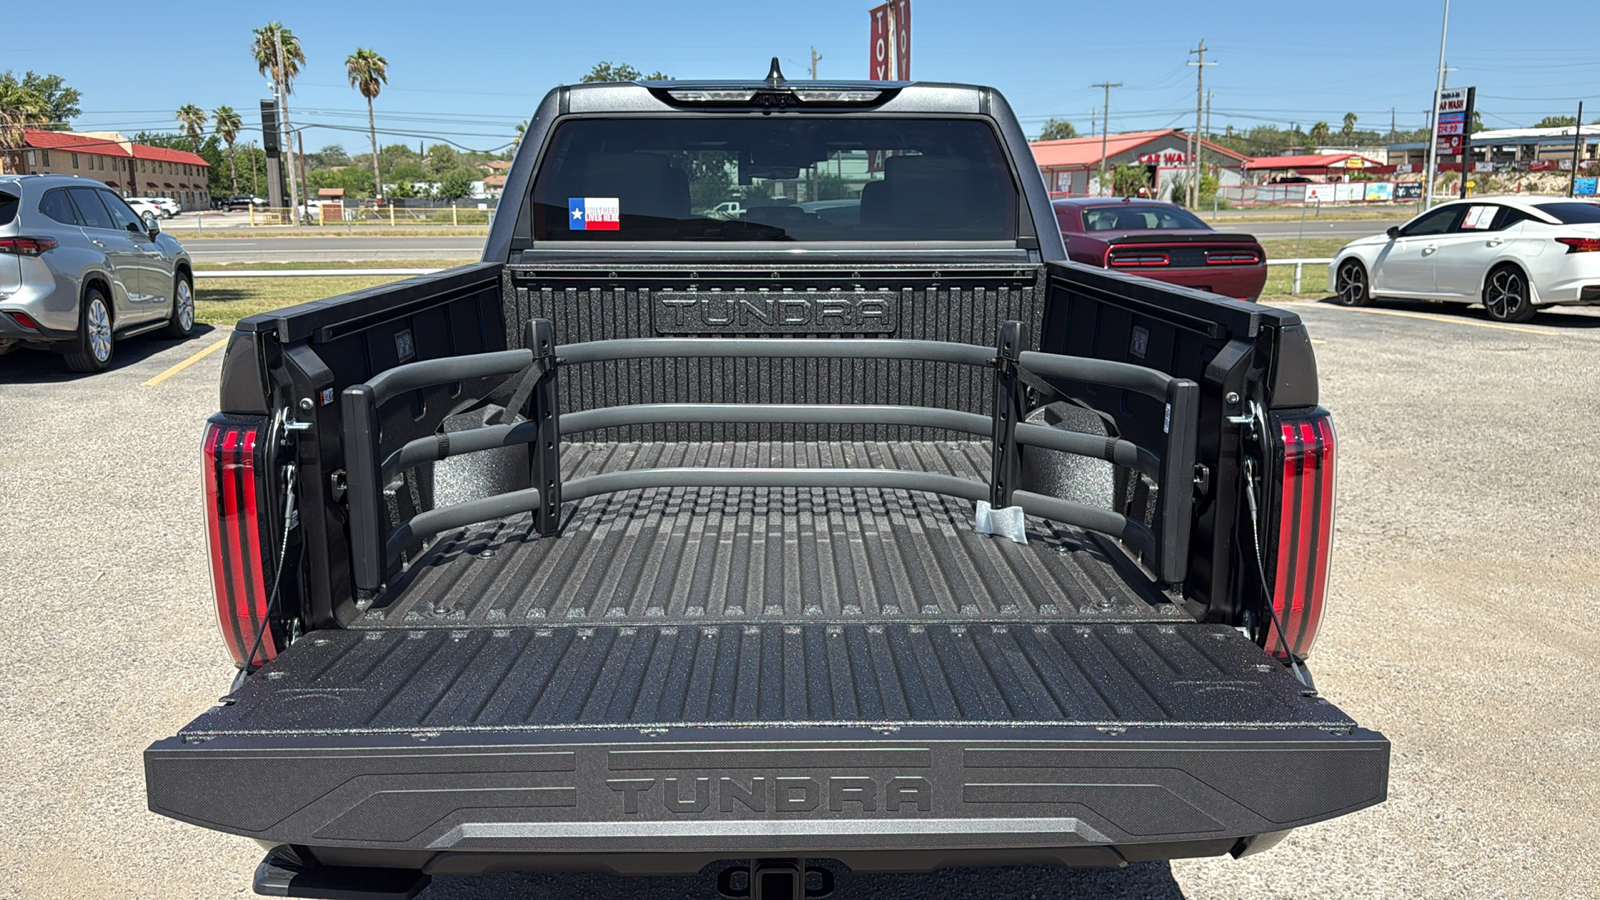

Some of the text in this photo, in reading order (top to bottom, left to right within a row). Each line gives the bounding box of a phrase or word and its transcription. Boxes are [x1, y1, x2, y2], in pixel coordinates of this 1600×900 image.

[899, 1, 907, 81] TOY
[1448, 99, 1464, 110] WASH
[1139, 153, 1160, 163] CAR
[586, 214, 620, 222] LIVES HERE
[662, 299, 890, 326] TUNDRA
[606, 776, 932, 814] TUNDRA
